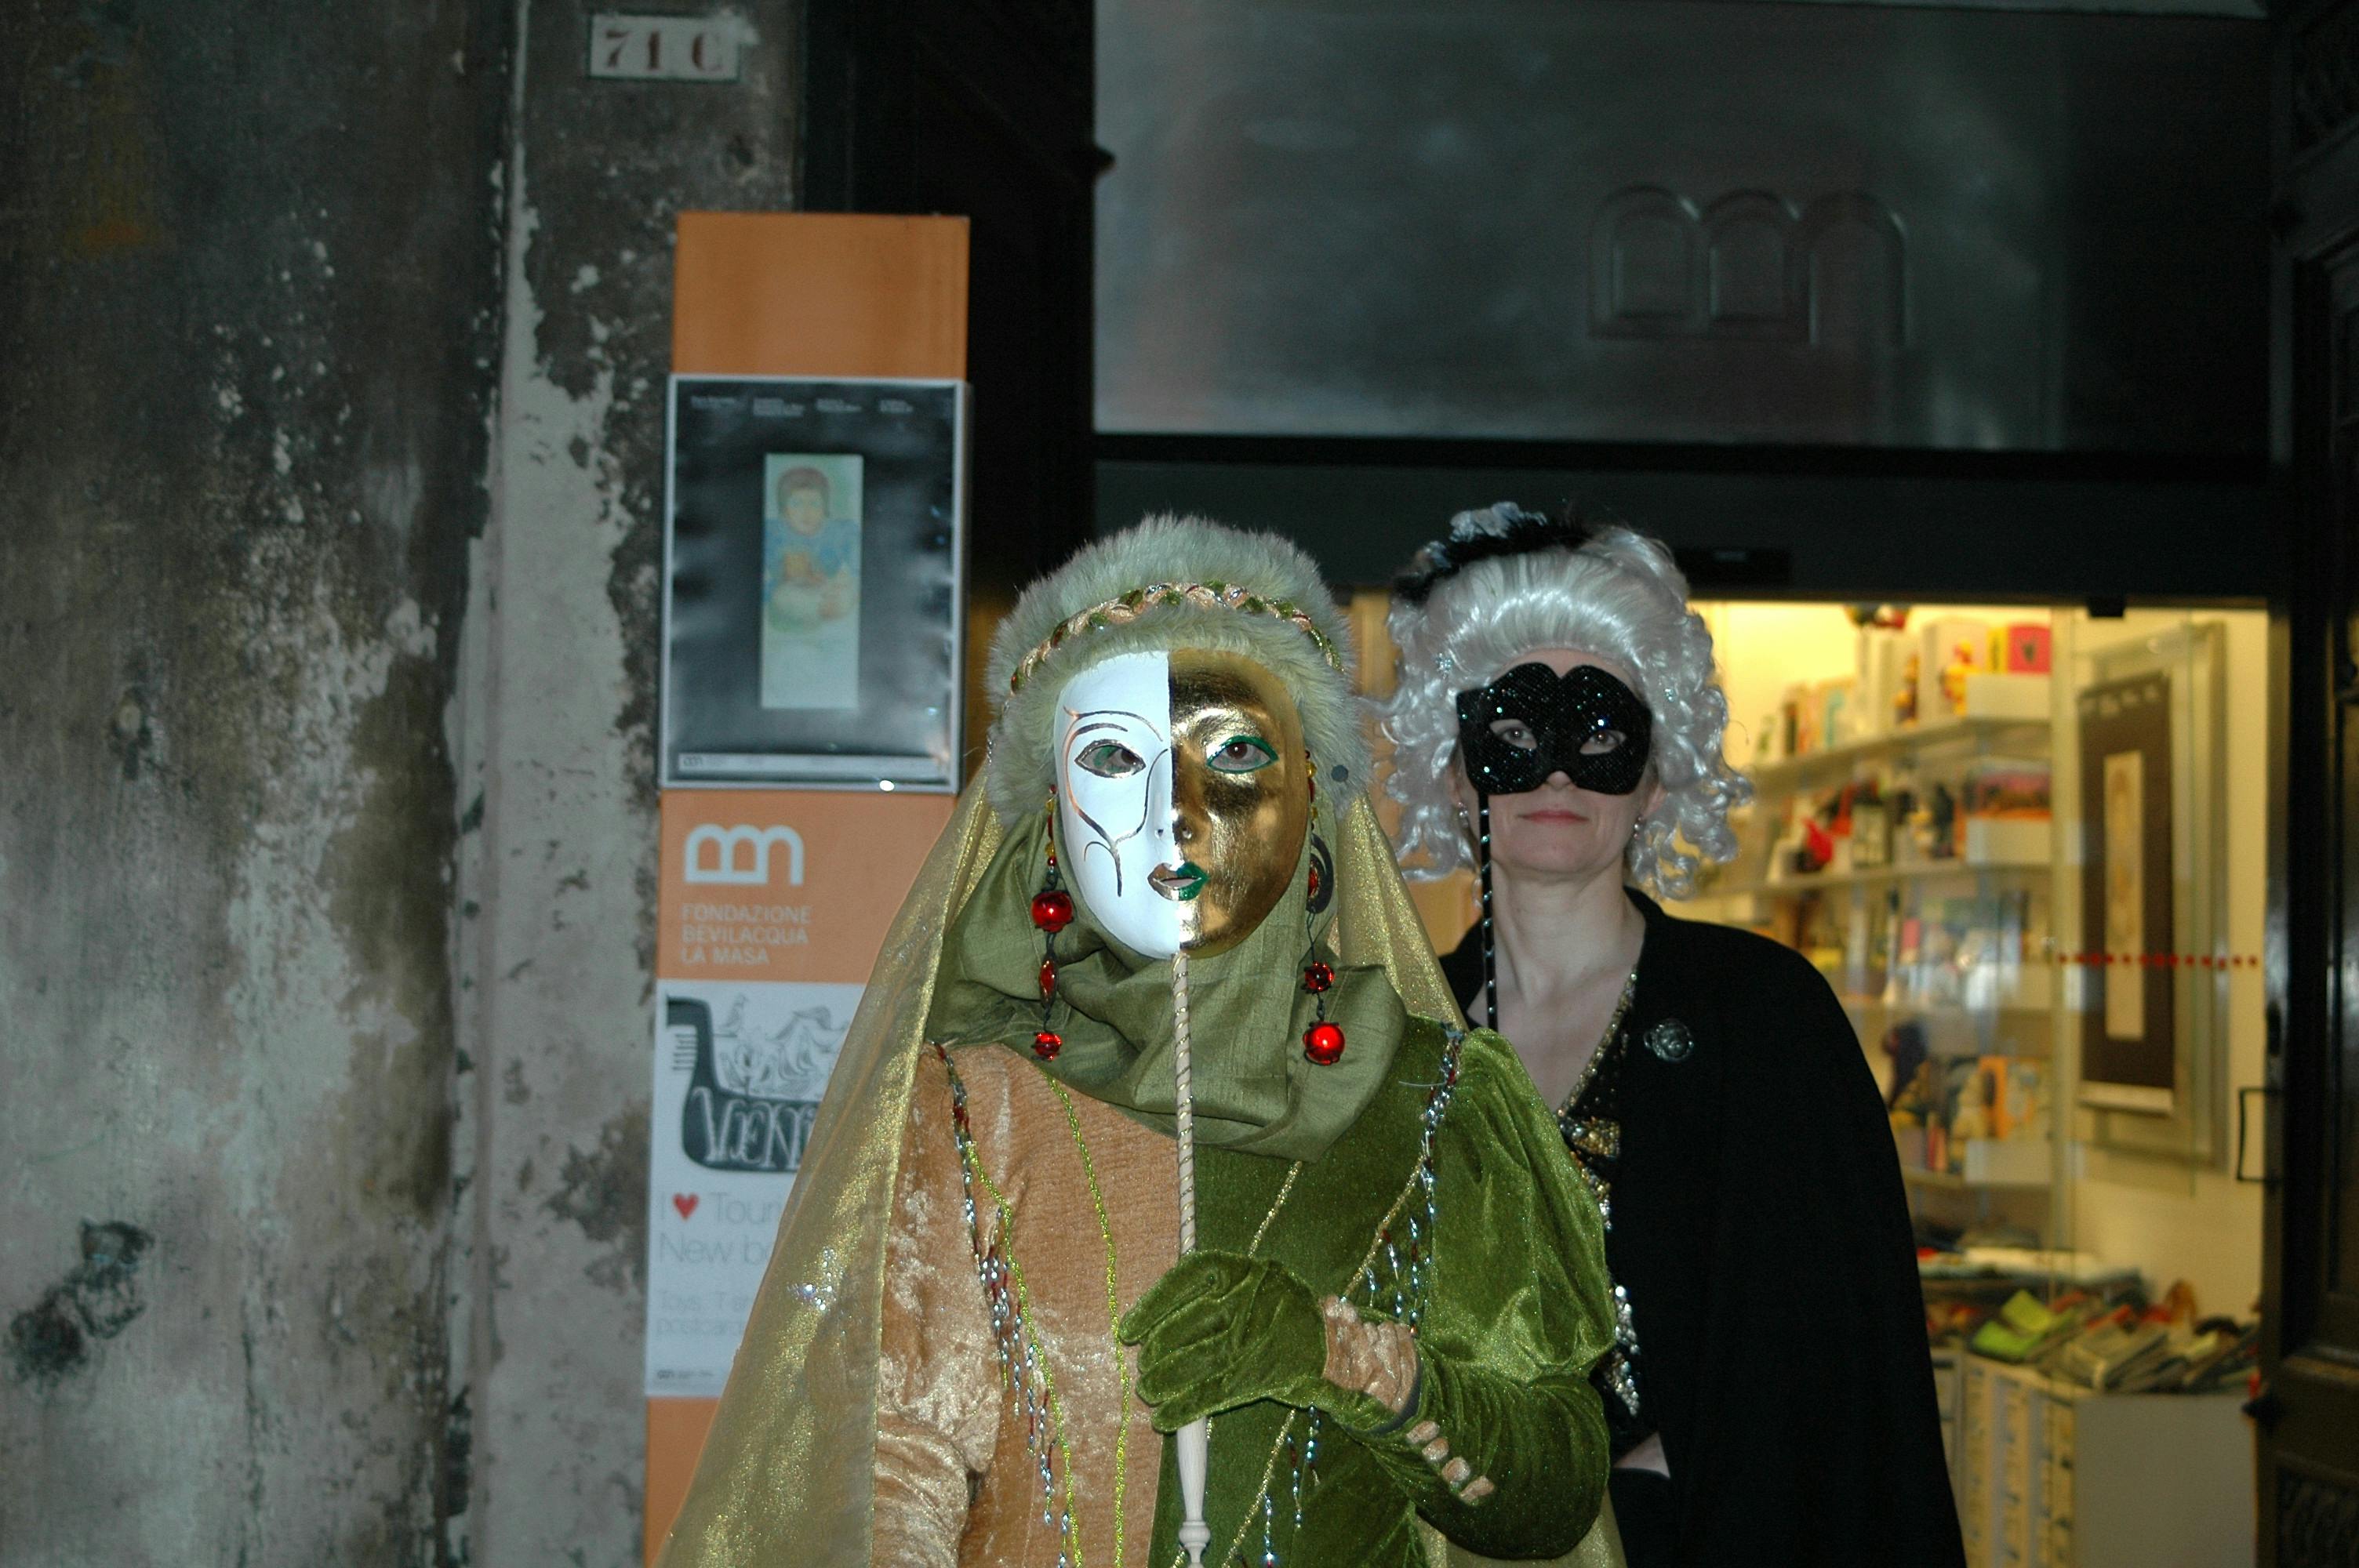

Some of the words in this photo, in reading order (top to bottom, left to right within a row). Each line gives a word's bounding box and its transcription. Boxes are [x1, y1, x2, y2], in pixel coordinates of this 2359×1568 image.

[681, 903, 812, 924] FONDAZIONE
[681, 924, 809, 945] BEVILACQUA
[680, 946, 705, 965] LA
[713, 947, 769, 965] MASA
[660, 1232, 732, 1265] New
